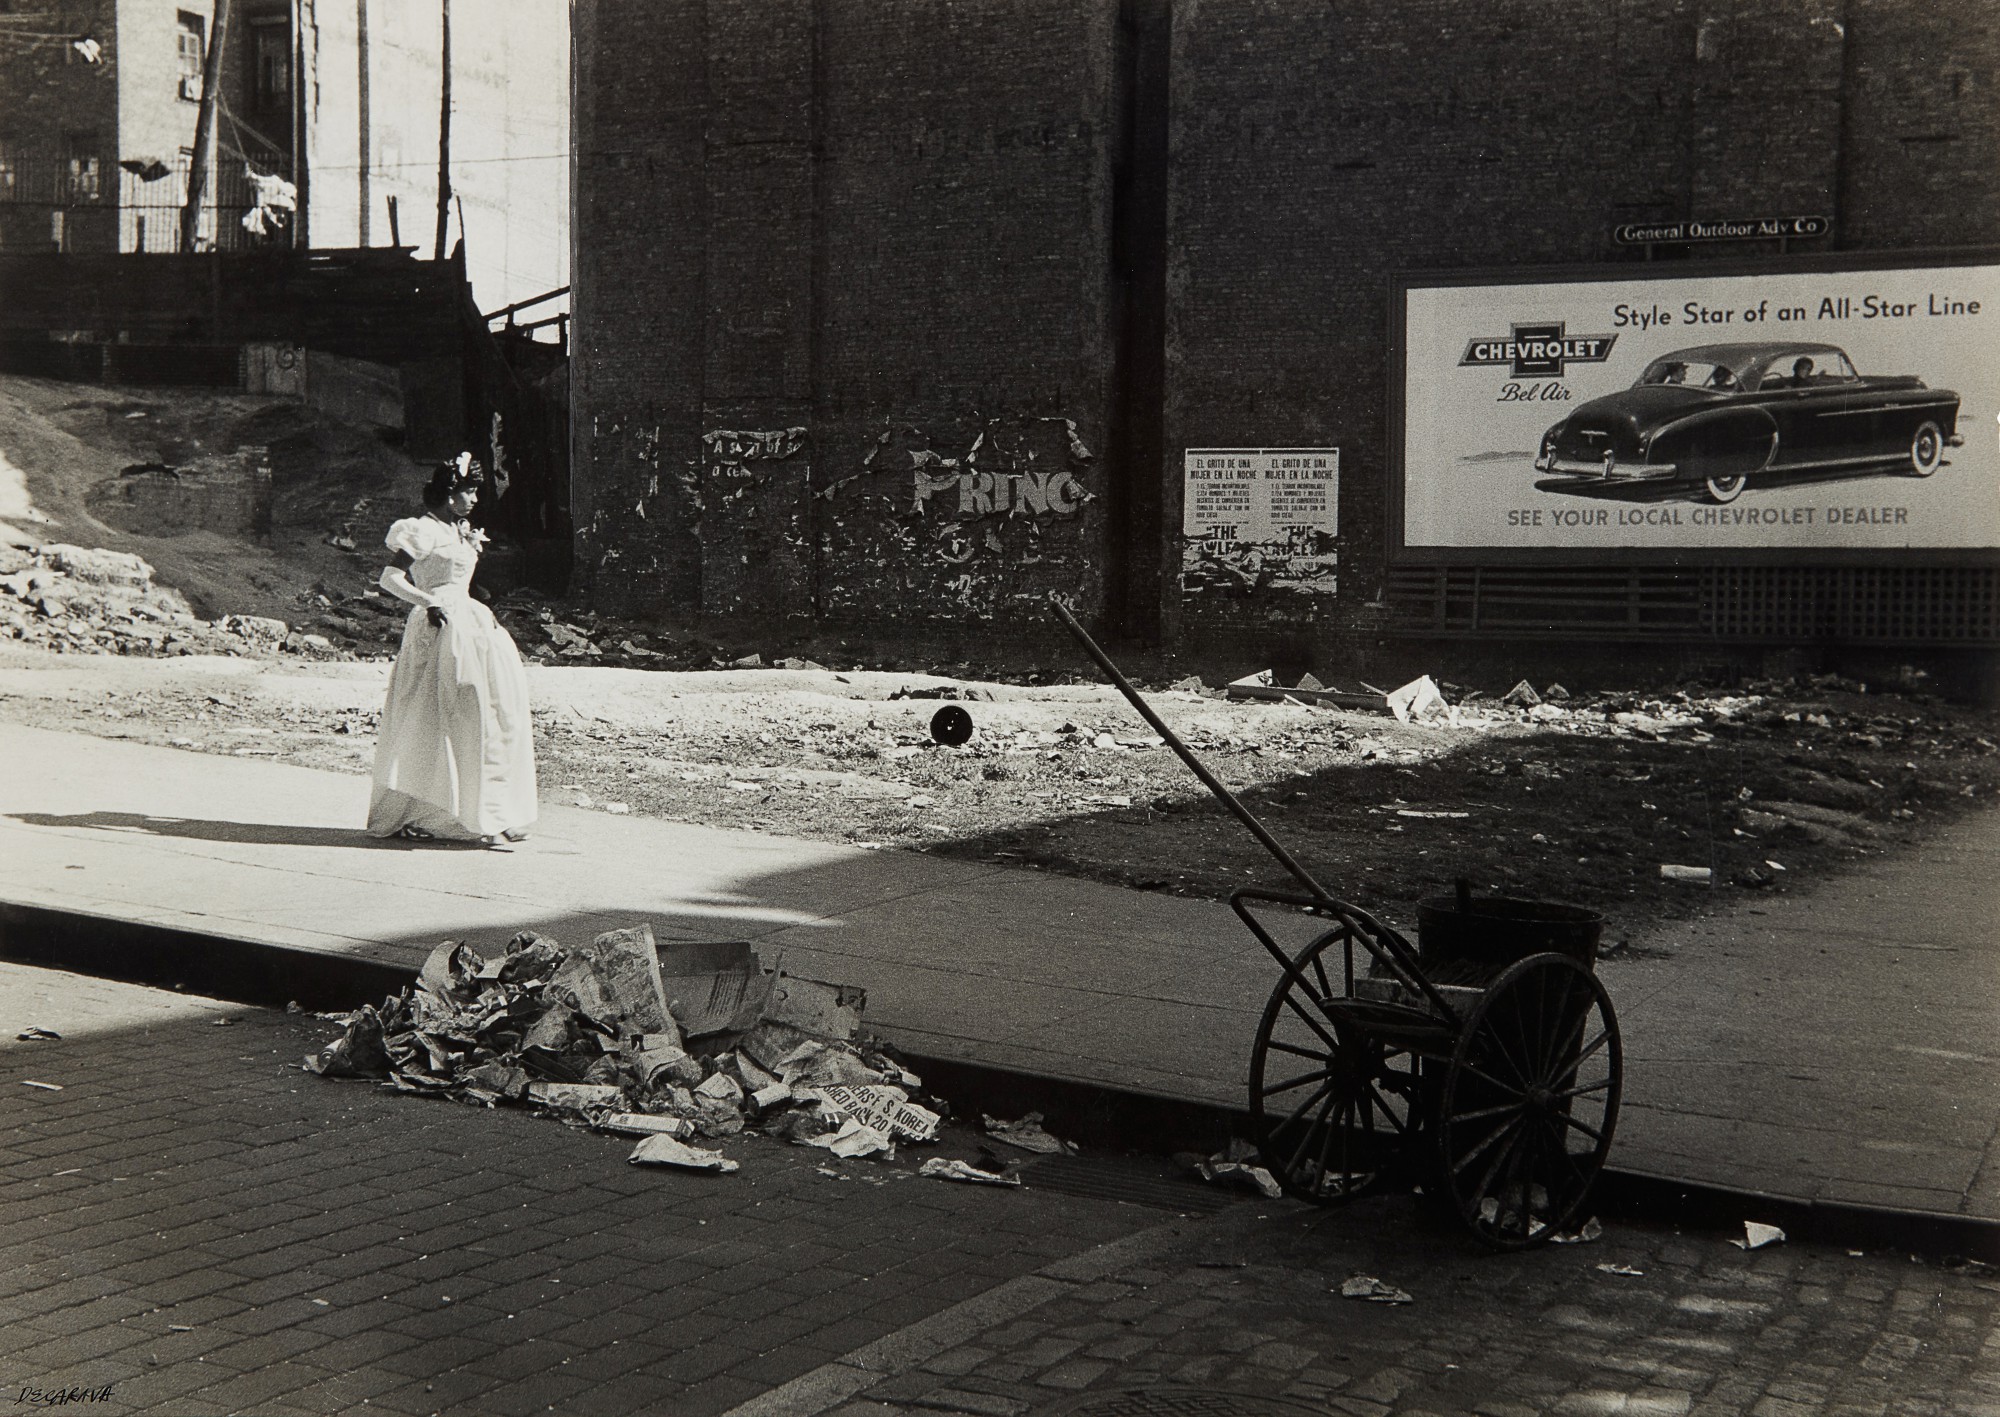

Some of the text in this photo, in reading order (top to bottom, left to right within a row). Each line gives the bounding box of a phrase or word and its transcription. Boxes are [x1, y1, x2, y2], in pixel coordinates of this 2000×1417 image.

[1623, 225, 1684, 241] General
[1690, 222, 1752, 238] Outdoor
[1794, 218, 1817, 233] Co
[1613, 293, 1982, 331] Style Star of an All-Star Line
[1475, 340, 1600, 360] CHEVROLET
[1497, 381, 1572, 402] Bel Air
[1197, 458, 1251, 468] EL GRITO DE UNA
[1272, 458, 1279, 468] EL
[1282, 458, 1300, 468] GRITO
[1303, 458, 1311, 468] DE
[1190, 470, 1257, 479] MUJER EN LA NOCHE
[1265, 470, 1285, 479] MUJER
[1290, 470, 1297, 479] EN
[1301, 470, 1309, 479] LA
[1507, 507, 1909, 527] SEE YOUR LOCAL CHEVROLET DEALER
[869, 1114, 889, 1132] 20
[893, 1107, 929, 1134] KOREA
